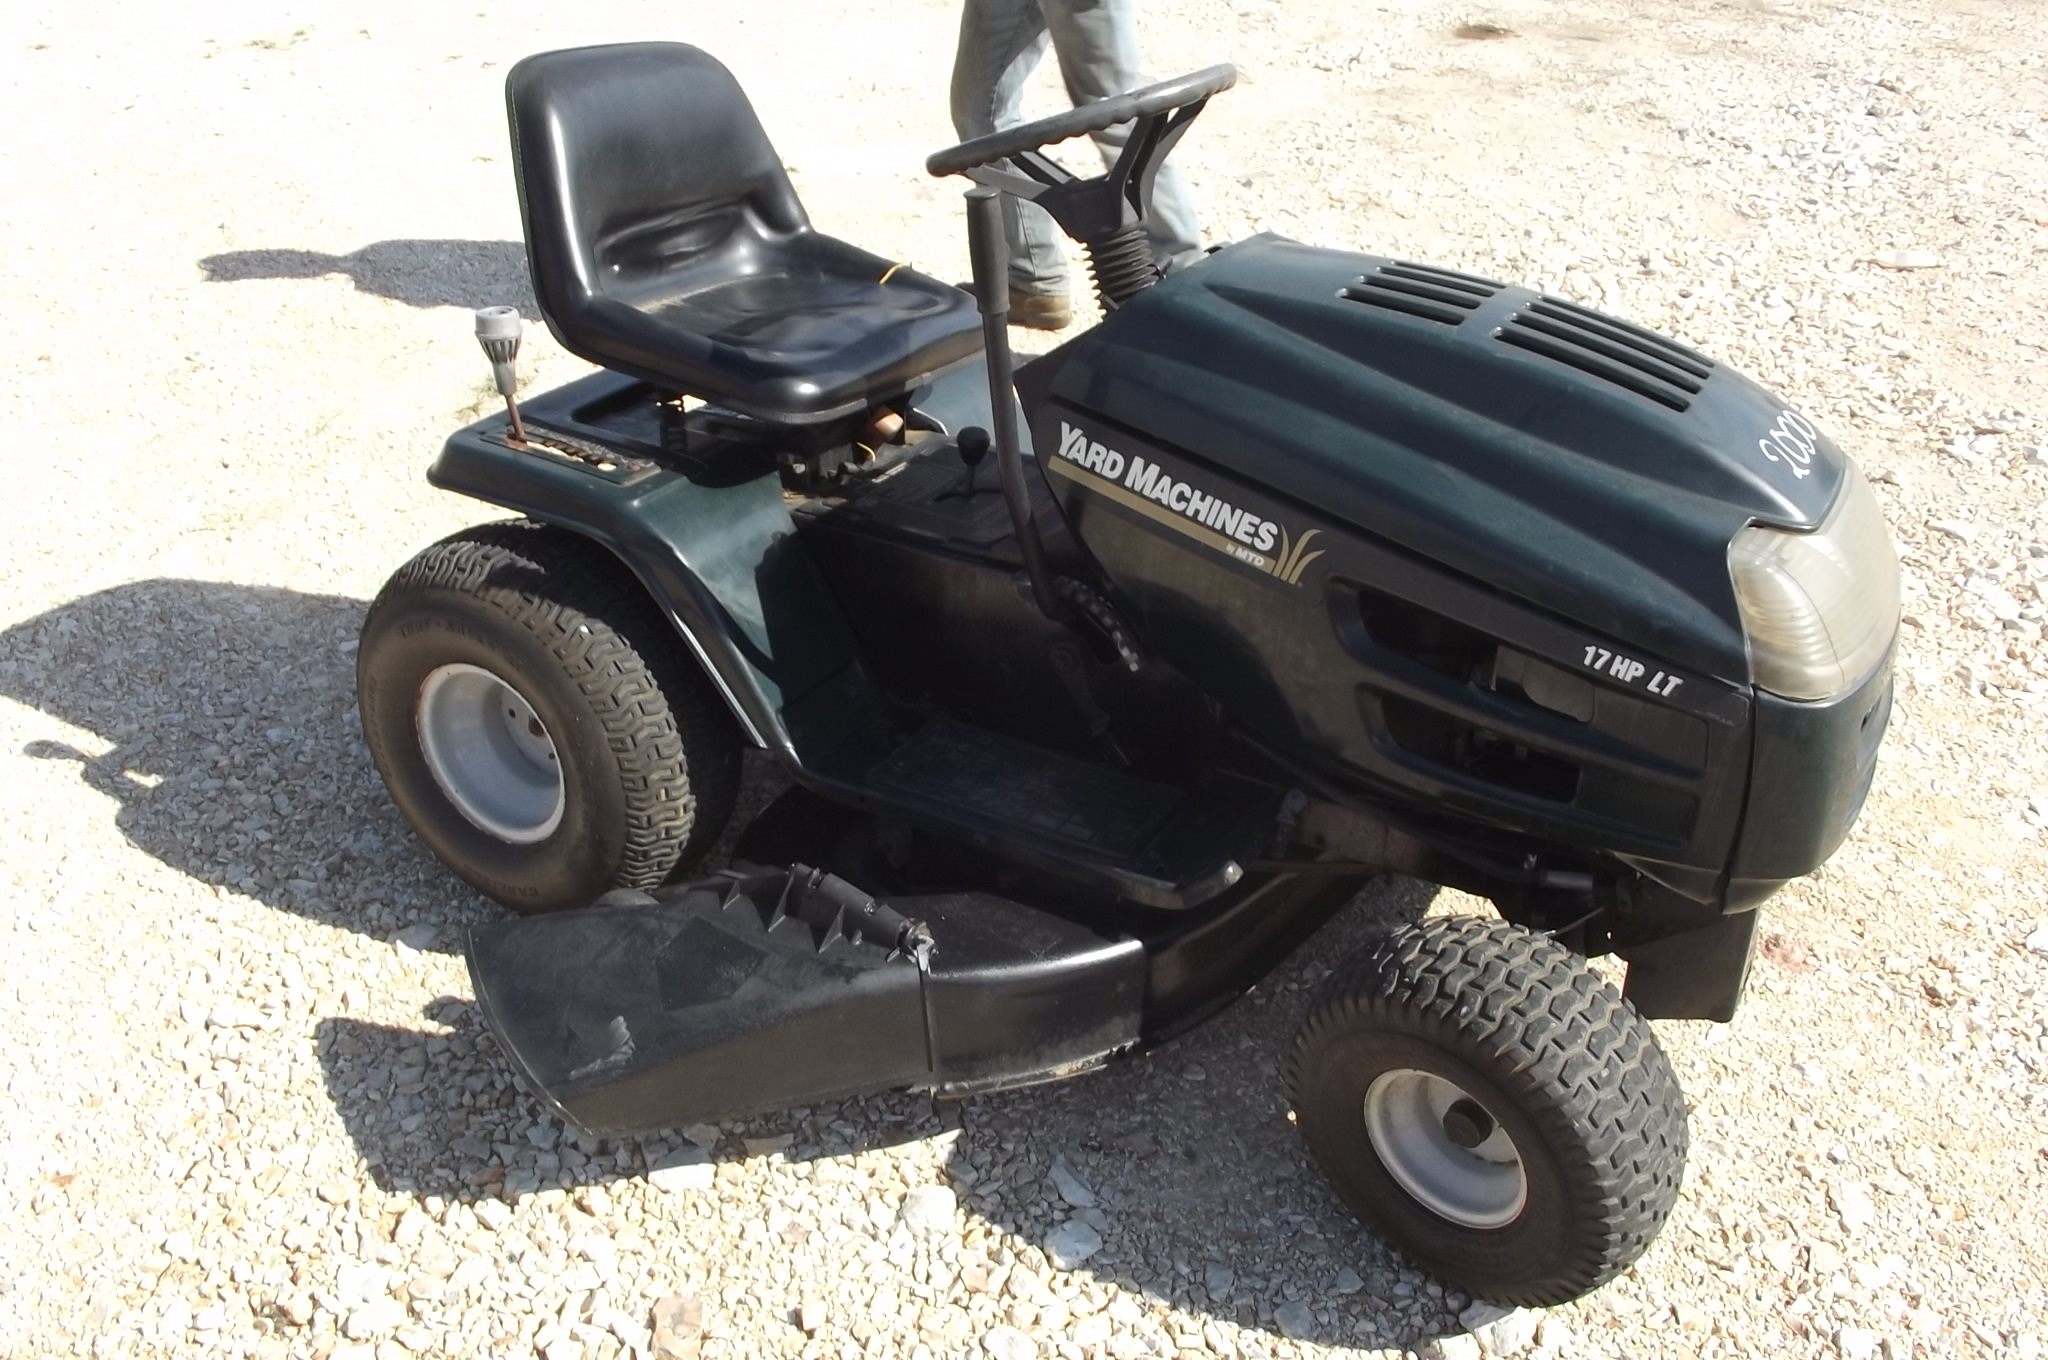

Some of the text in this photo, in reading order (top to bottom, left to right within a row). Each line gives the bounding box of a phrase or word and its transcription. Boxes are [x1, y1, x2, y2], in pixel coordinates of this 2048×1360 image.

[1058, 421, 1279, 551] YARD MACHINES
[1235, 547, 1265, 567] MTD
[1583, 645, 1684, 697] 17 HP LT
